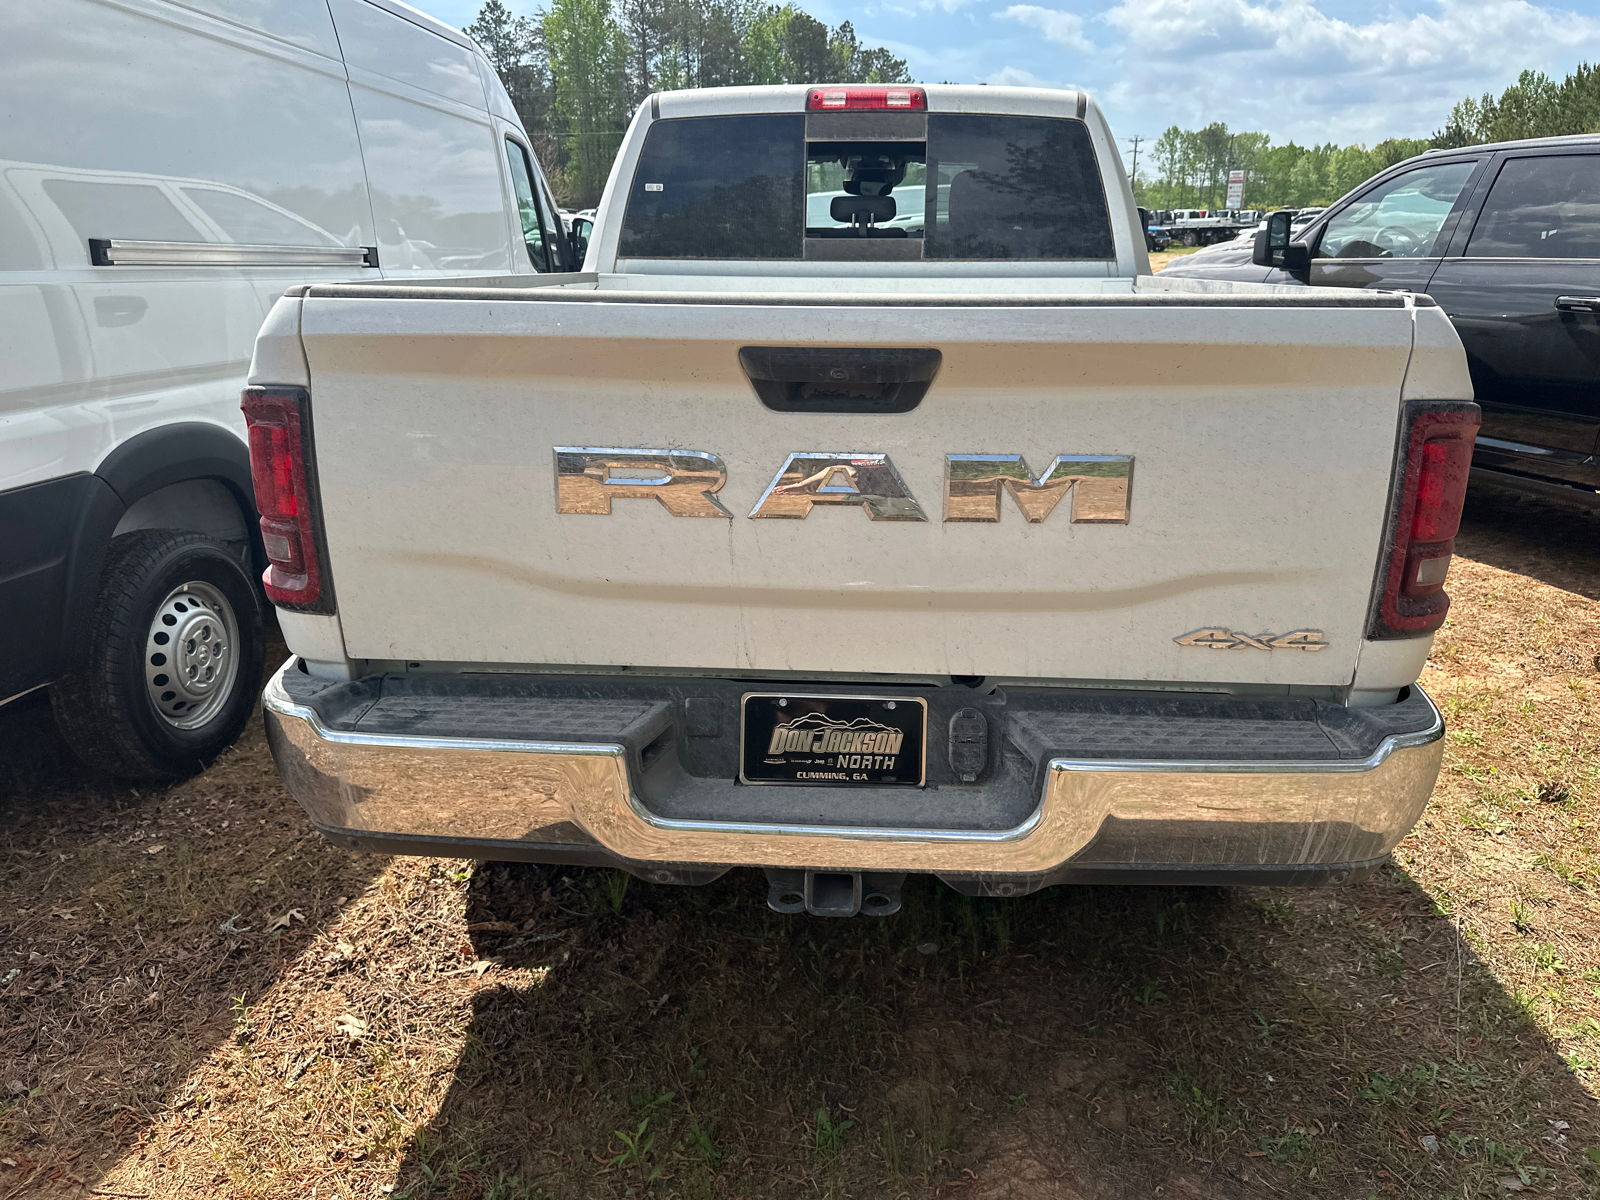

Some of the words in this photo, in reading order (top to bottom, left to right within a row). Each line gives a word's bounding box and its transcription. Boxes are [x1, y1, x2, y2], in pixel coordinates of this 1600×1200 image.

[553, 446, 1135, 524] RAM
[836, 755, 896, 770] NORTH
[797, 771, 850, 781] CUMMING,
[853, 772, 869, 781] GA
